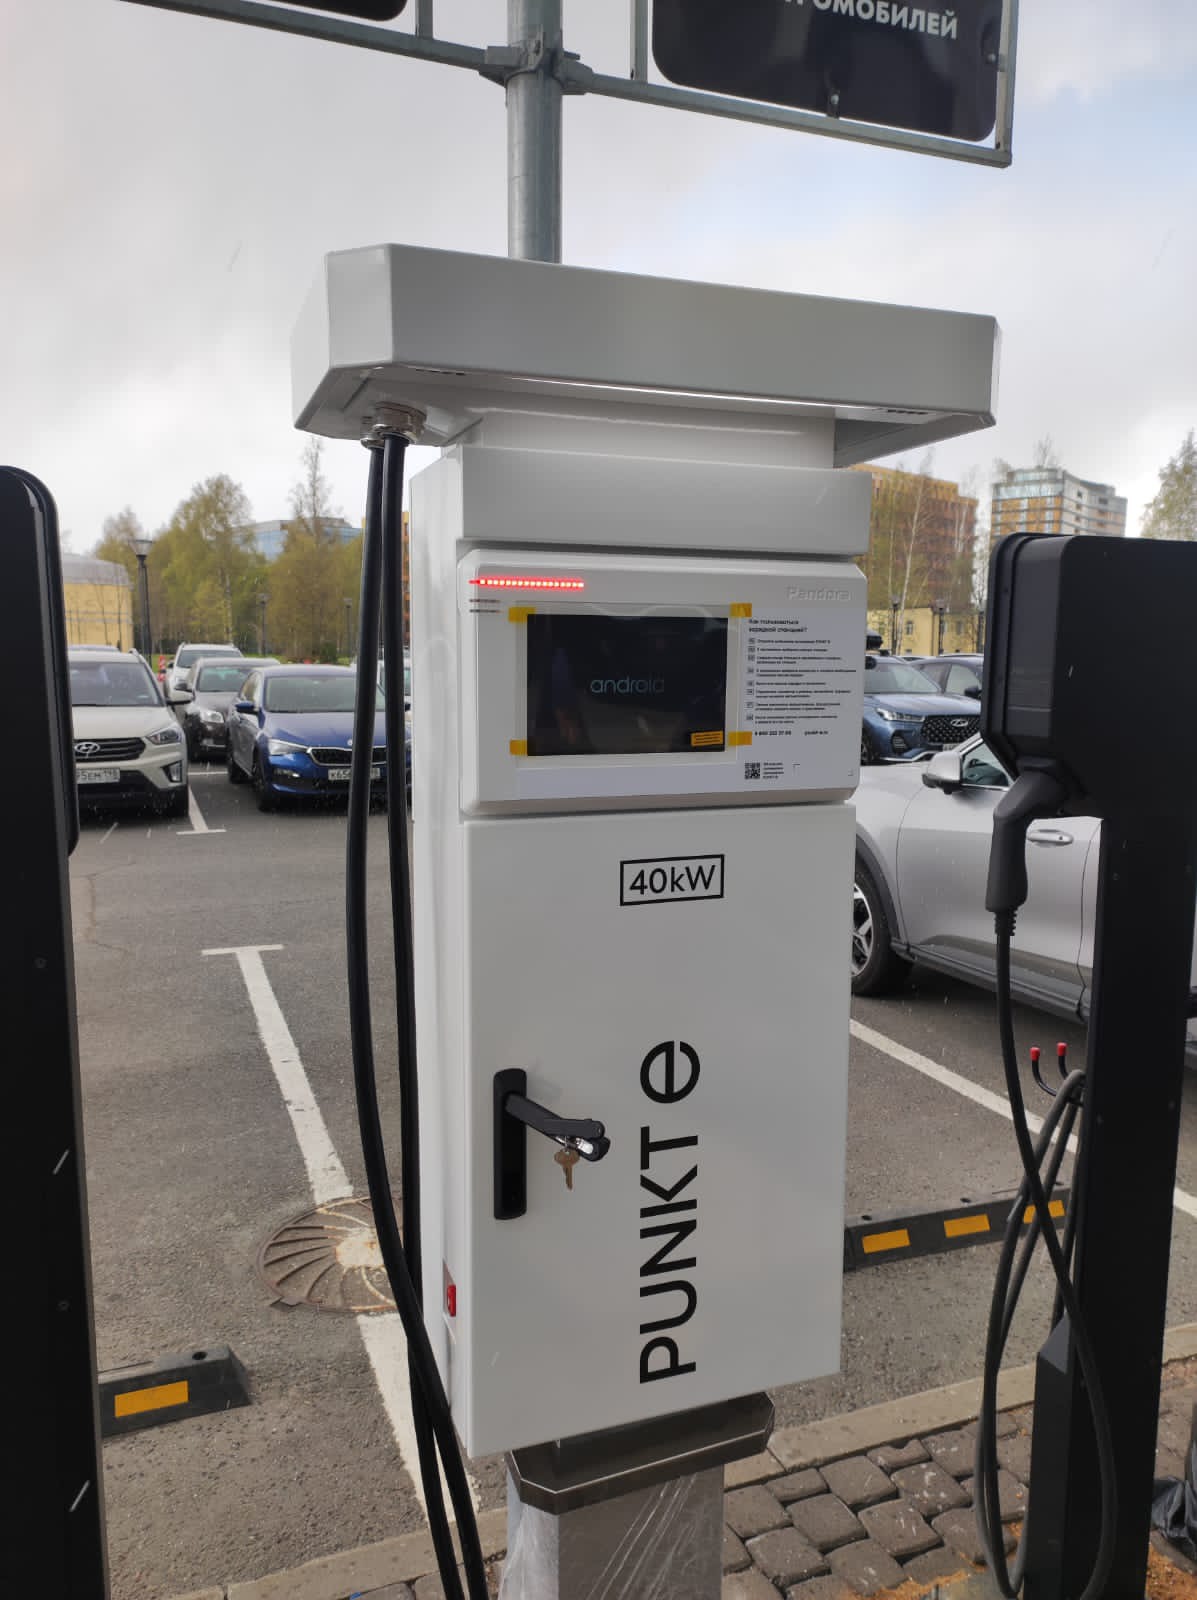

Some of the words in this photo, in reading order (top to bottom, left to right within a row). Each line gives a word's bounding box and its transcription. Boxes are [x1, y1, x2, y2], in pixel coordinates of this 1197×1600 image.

[786, 0, 958, 39] ОМОБИЛЕЙ
[786, 585, 852, 601] Pandora
[590, 676, 665, 694] android
[629, 864, 717, 896] 40kW
[639, 1040, 700, 1104] e
[639, 1125, 699, 1384] PUNKT
